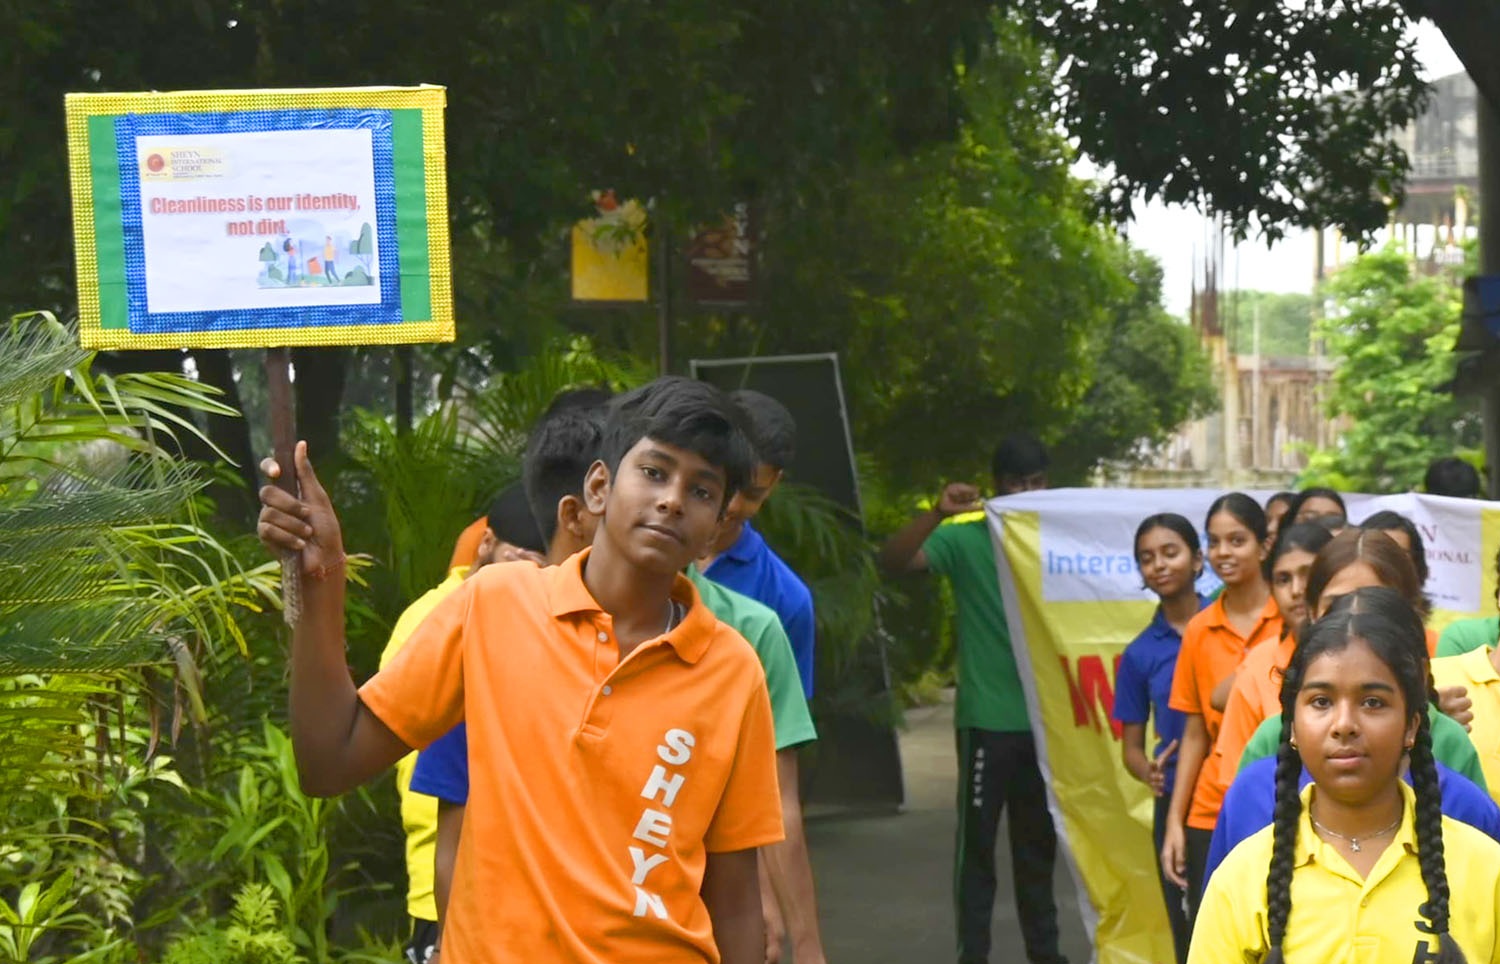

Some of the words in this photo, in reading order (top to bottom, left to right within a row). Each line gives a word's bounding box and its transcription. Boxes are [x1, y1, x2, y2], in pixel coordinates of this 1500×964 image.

[150, 194, 245, 214] Cleanliness
[248, 195, 263, 211] is
[266, 196, 294, 211] our
[296, 193, 360, 214] identity,
[227, 219, 255, 236] not
[258, 217, 290, 235] dirt.
[1047, 550, 1132, 576] Intera
[628, 728, 695, 920] SHEYN
